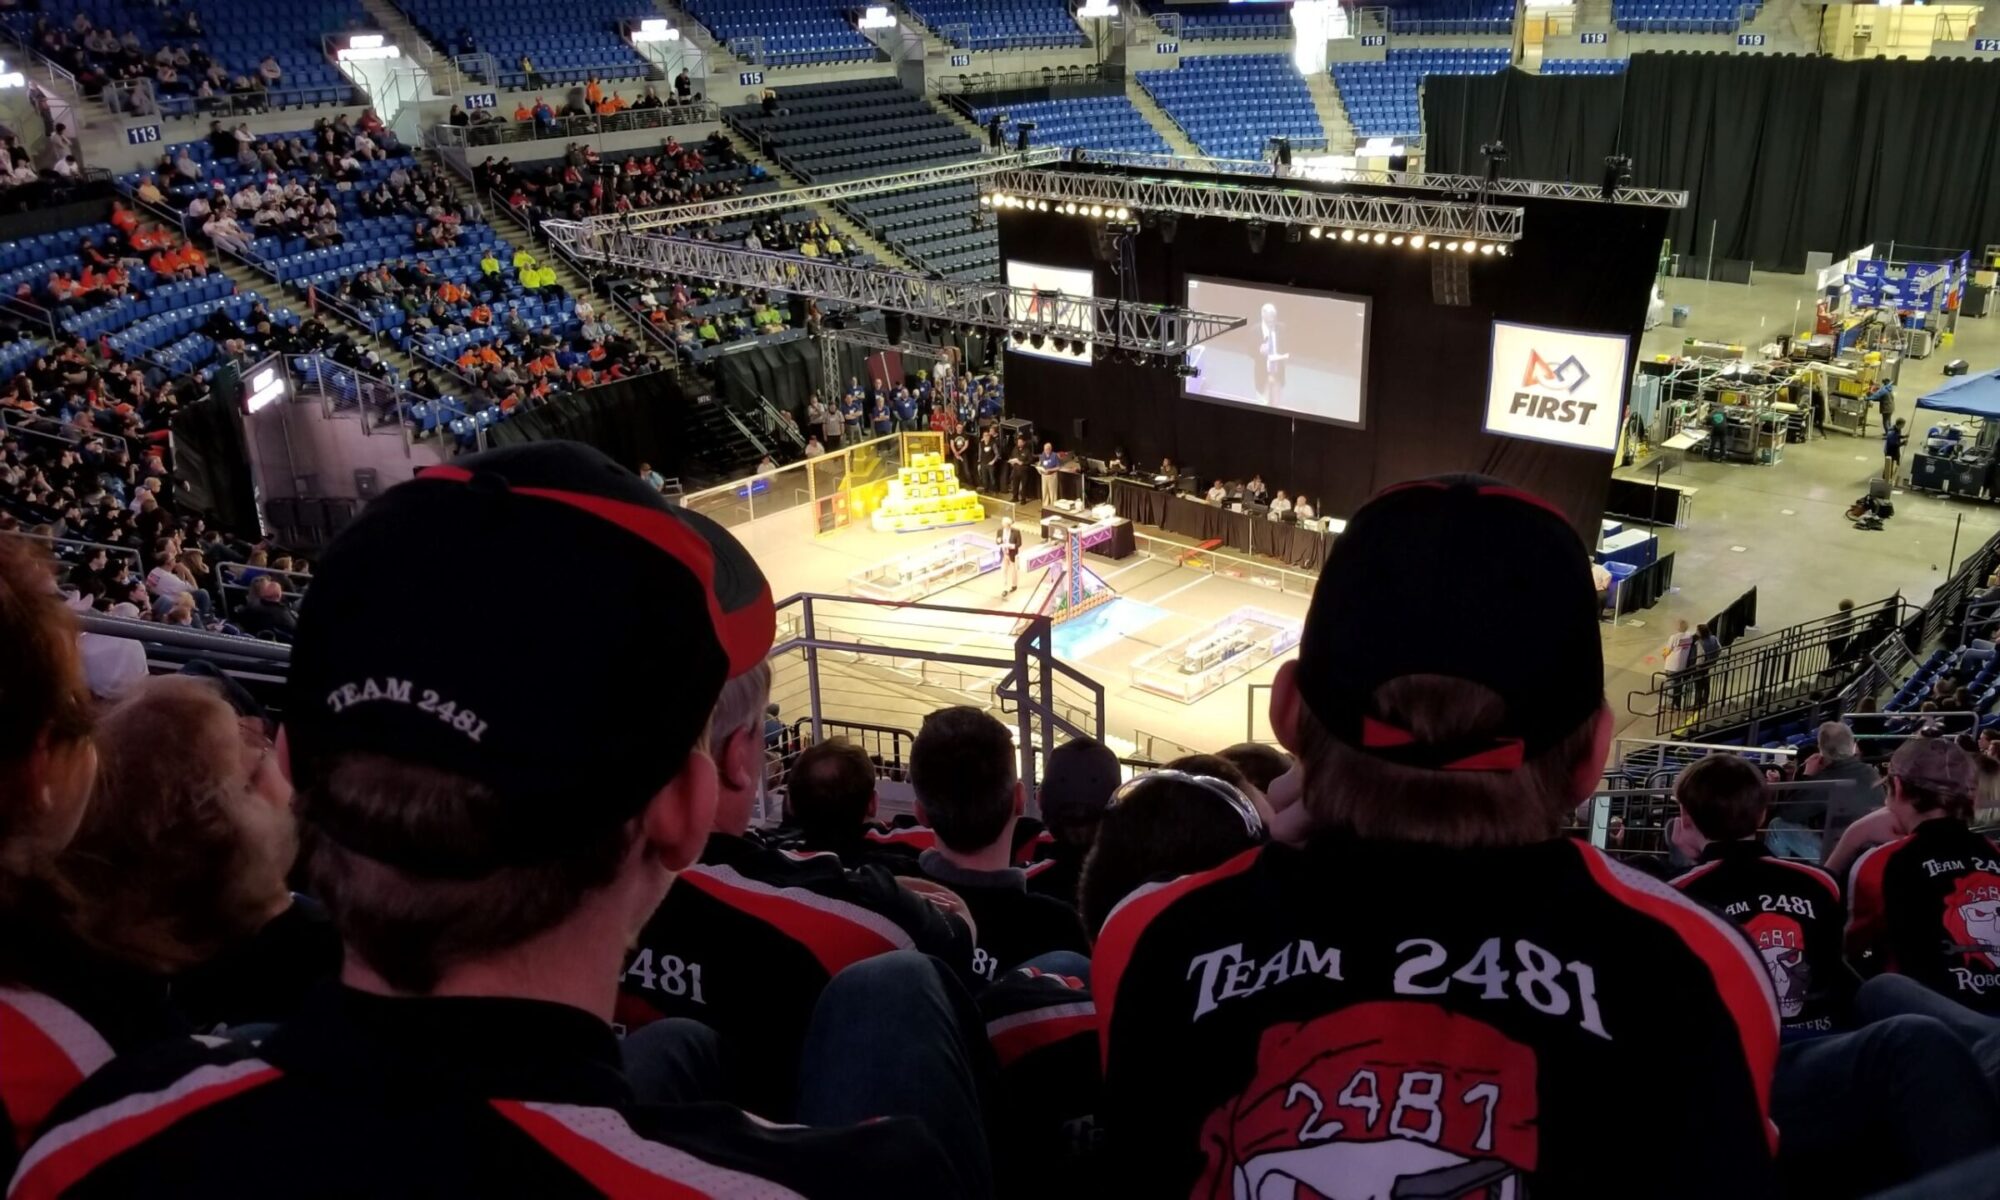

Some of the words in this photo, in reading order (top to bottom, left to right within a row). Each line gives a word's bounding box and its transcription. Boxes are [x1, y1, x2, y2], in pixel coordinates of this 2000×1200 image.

[1365, 36, 1383, 46] 118
[1584, 33, 1605, 43] 119
[1741, 35, 1762, 46] 119
[1159, 43, 1176, 53] 117
[742, 72, 761, 85] 115
[468, 94, 493, 108] 114
[131, 126, 157, 144] 113
[1508, 392, 1598, 425] FIRST
[327, 677, 413, 713] TEAM
[417, 689, 488, 742] 2481
[1758, 894, 1817, 920] 2481
[1758, 929, 1796, 949] 481
[619, 947, 708, 1005] 481
[1393, 937, 1613, 1041] 2481
[1284, 1069, 1500, 1151] 2481
